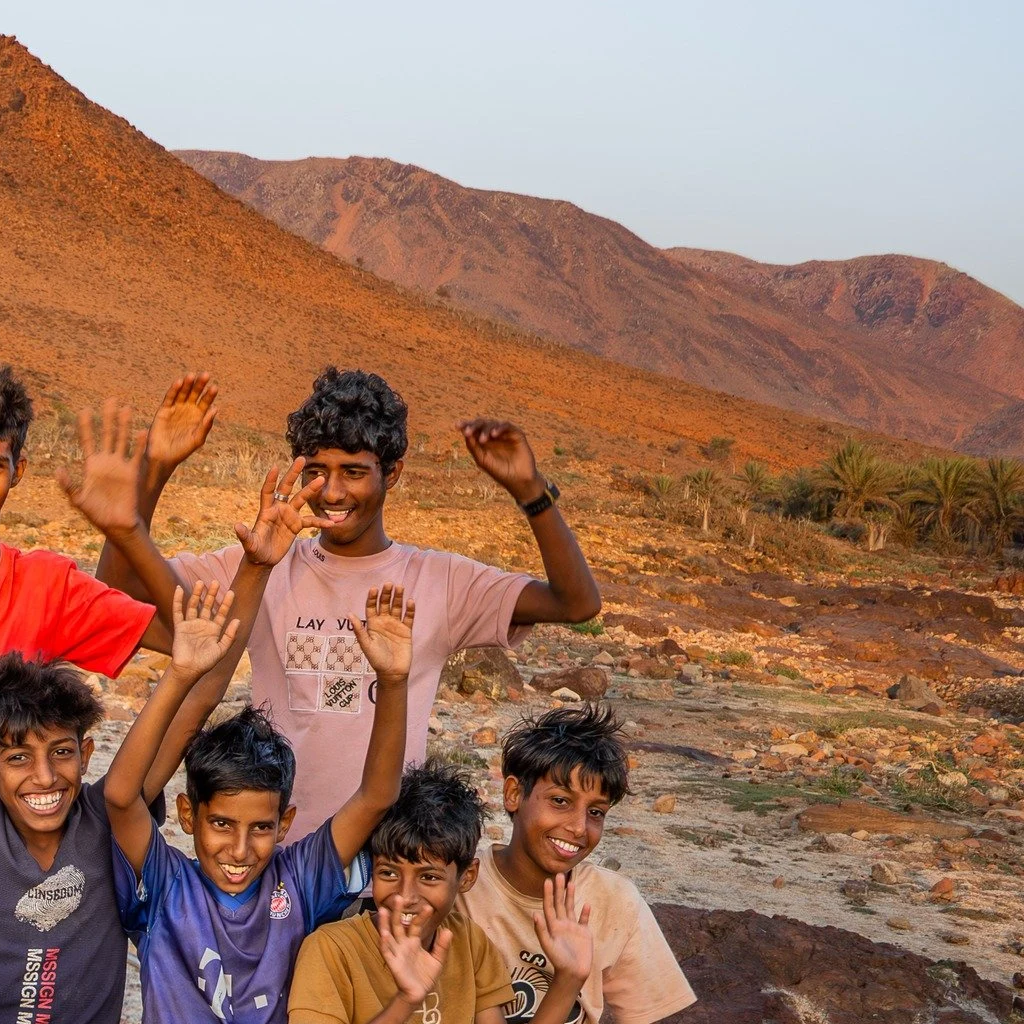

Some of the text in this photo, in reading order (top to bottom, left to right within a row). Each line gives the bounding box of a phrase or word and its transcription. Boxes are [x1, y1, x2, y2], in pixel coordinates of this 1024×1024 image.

[296, 616, 367, 631] LAY VUT
[325, 678, 346, 698] LOUIS
[326, 680, 357, 707] VUITTON
[339, 694, 353, 707] CUP
[20, 948, 43, 1008] MSSIGN
[37, 947, 60, 1010] MSSIGN
